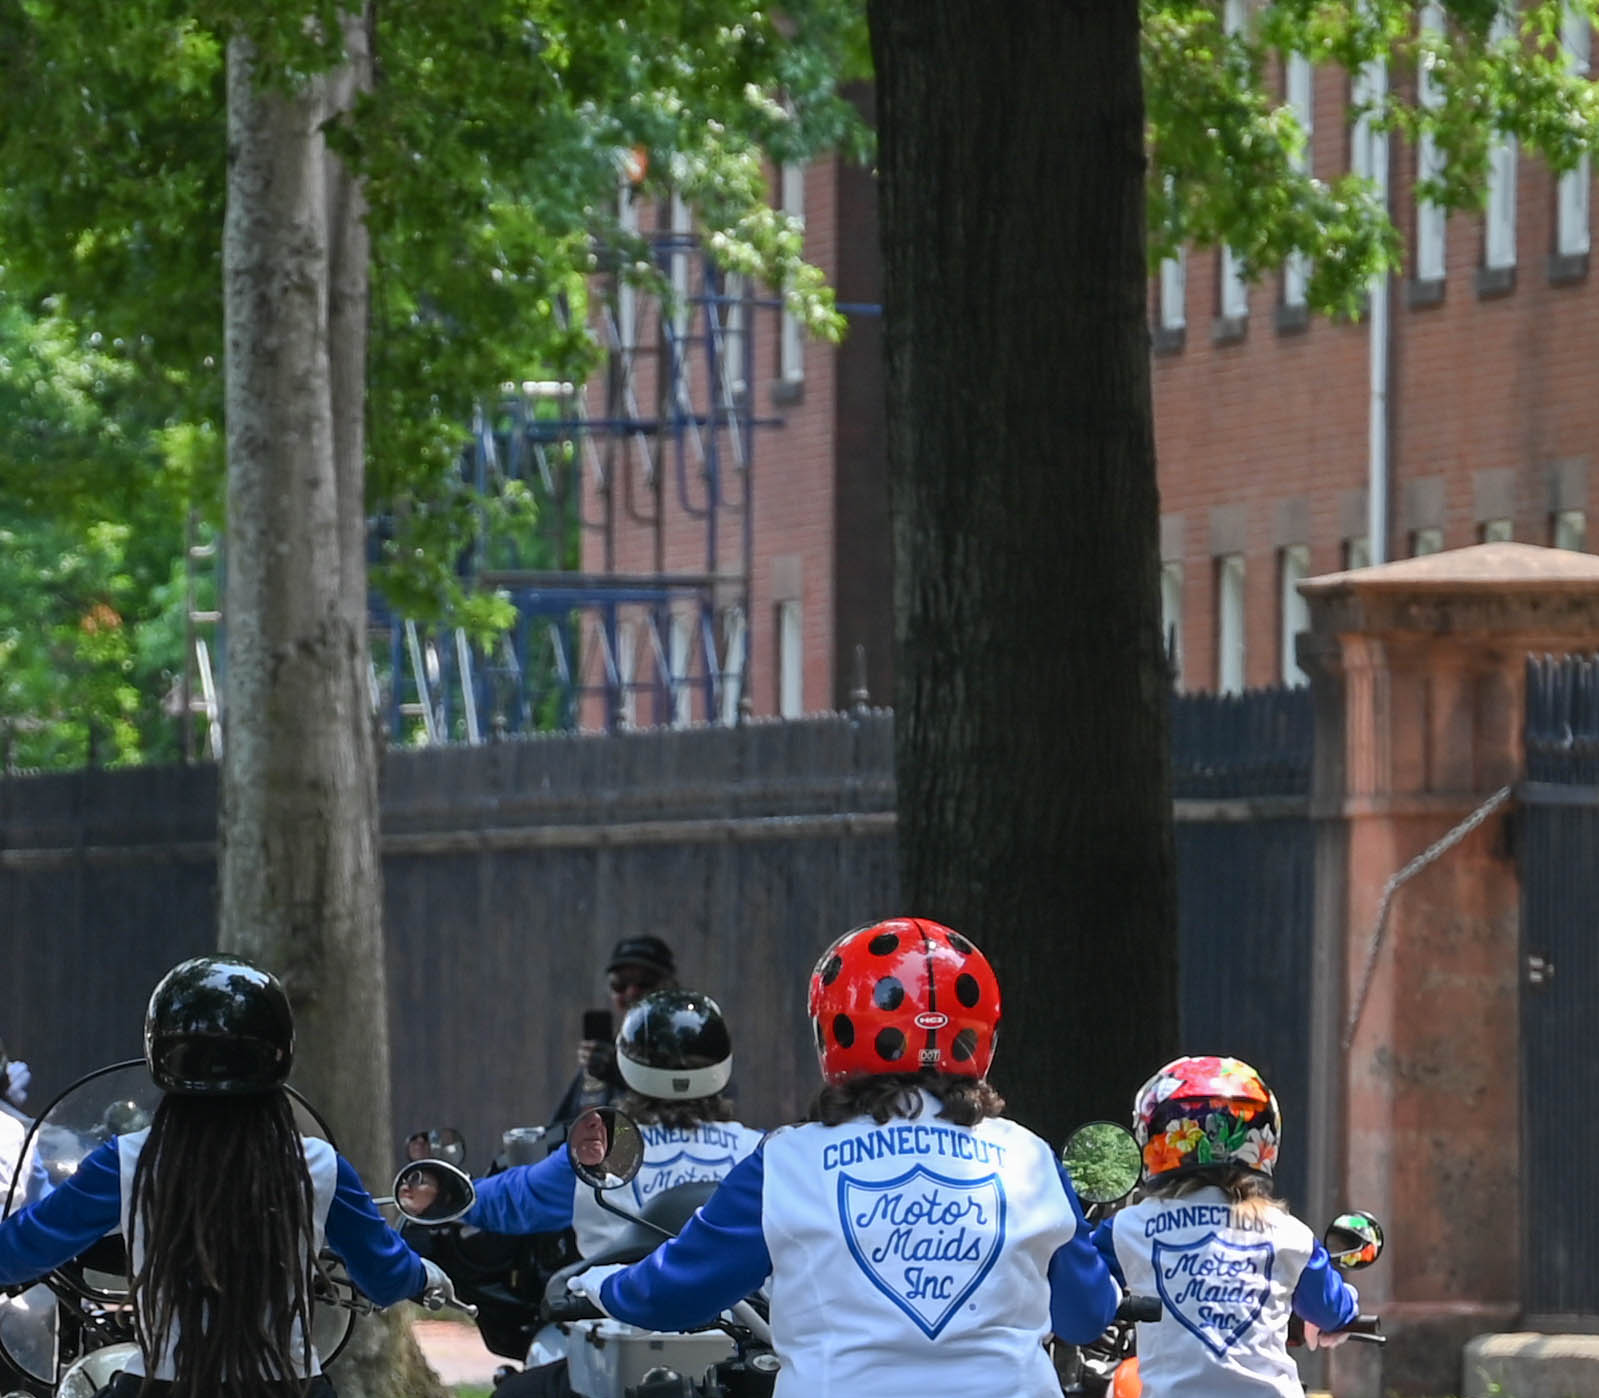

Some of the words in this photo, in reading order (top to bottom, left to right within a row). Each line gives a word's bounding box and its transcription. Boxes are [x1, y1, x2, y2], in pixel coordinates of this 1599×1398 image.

[823, 1124, 1006, 1171] CONNECTICUT
[856, 1189, 988, 1228] Motor
[872, 1226, 982, 1264] Maids
[904, 1266, 954, 1300] Inc
[1165, 1251, 1257, 1280] Motor
[1175, 1278, 1257, 1304] Maids
